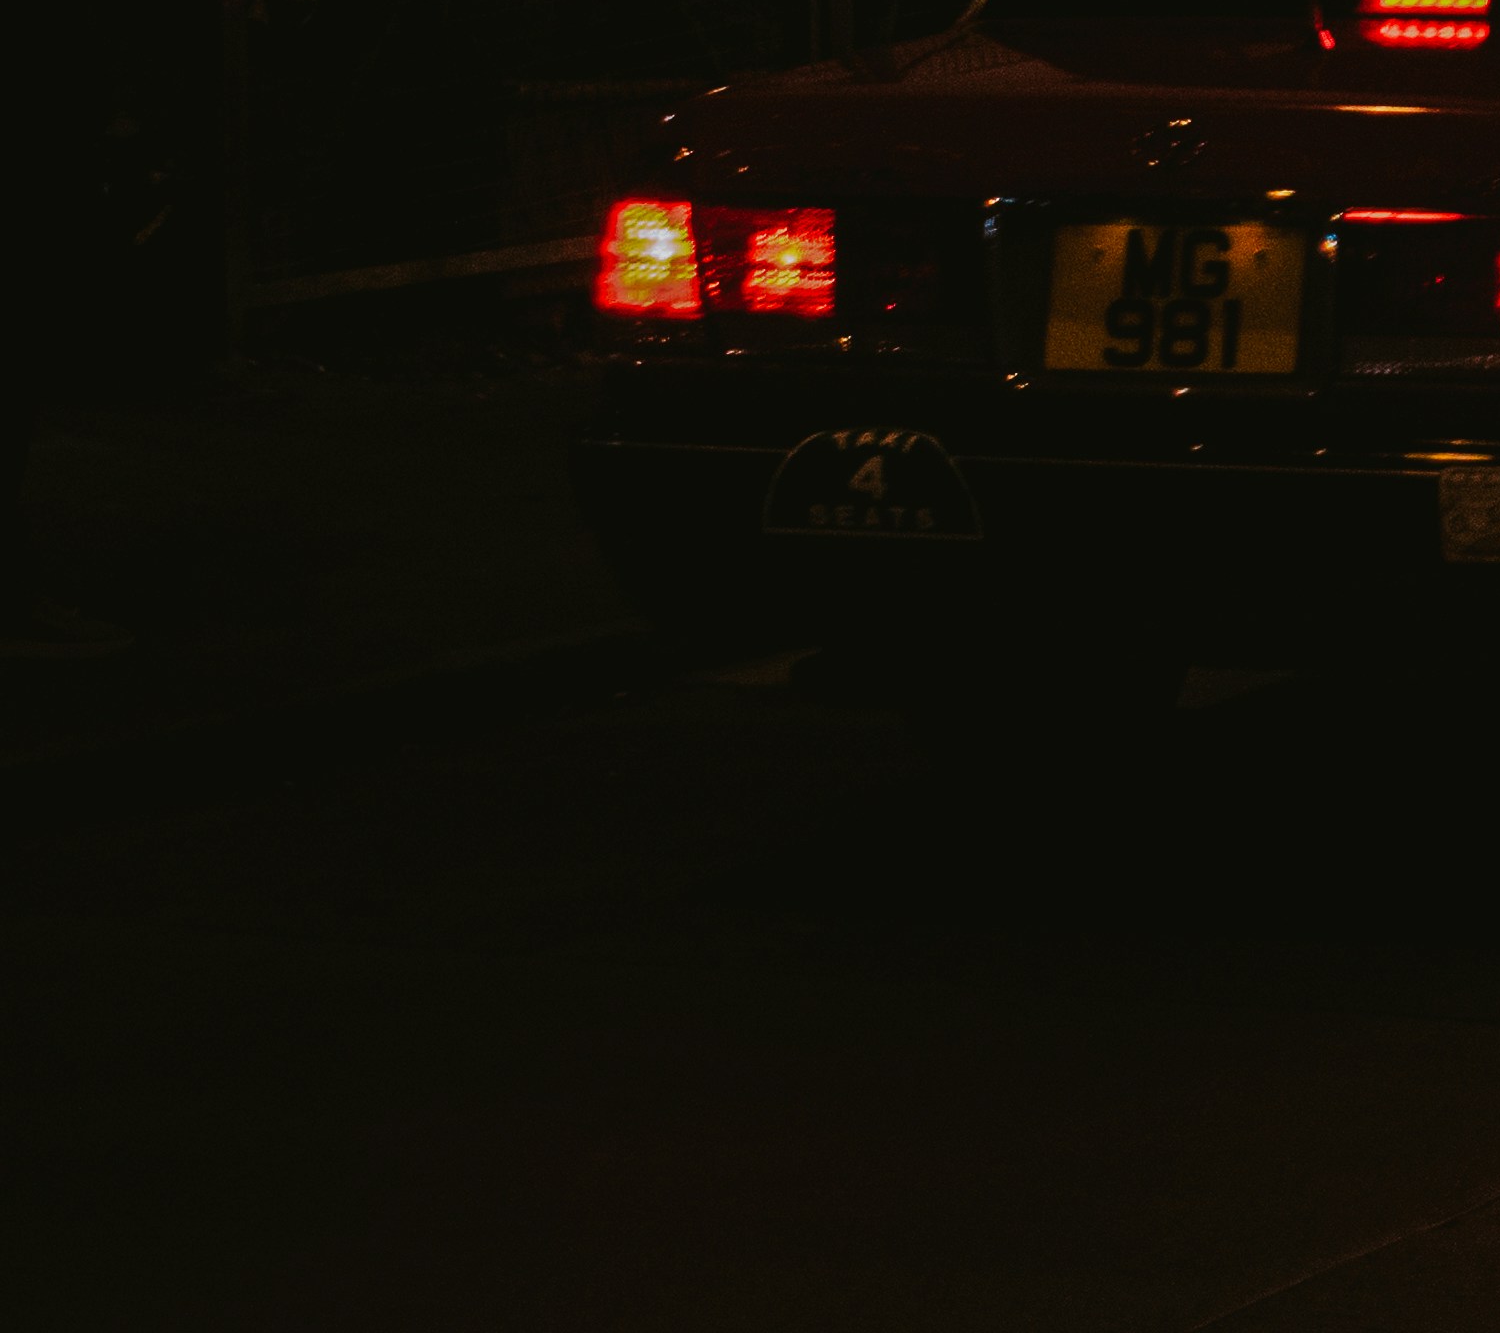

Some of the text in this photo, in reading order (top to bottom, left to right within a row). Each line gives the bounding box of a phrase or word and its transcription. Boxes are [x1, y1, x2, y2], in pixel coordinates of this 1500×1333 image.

[1122, 227, 1231, 299] MG
[1102, 298, 1243, 370] 981
[849, 453, 888, 501] 4
[808, 503, 937, 530] SEATS
